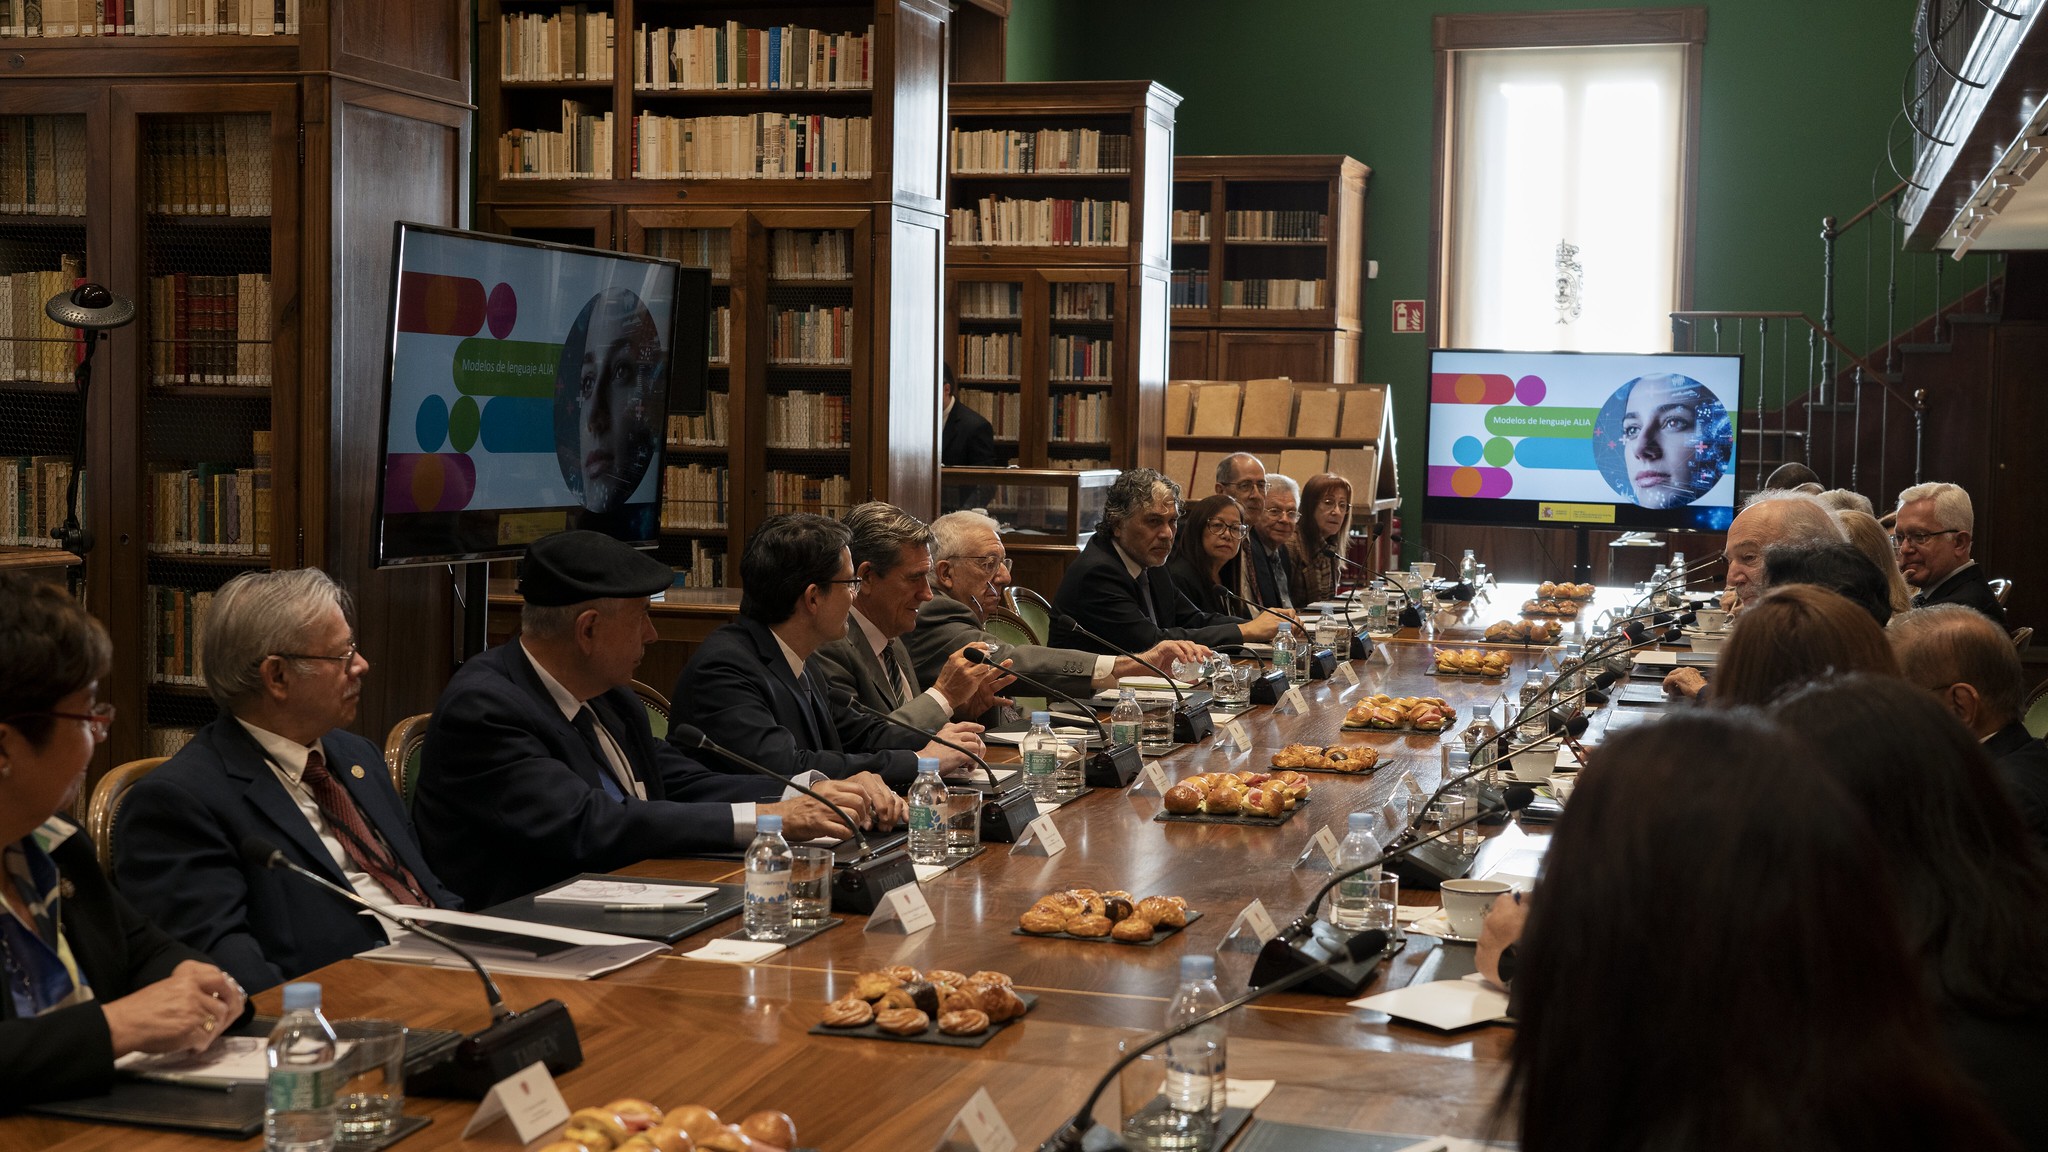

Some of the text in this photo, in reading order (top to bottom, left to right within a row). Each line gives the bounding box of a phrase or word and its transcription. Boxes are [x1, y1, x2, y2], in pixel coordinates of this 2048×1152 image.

[462, 359, 554, 376] Modelos de lenguaje ALIA
[1493, 416, 1591, 427] Modelos de lenguaje ALIA
